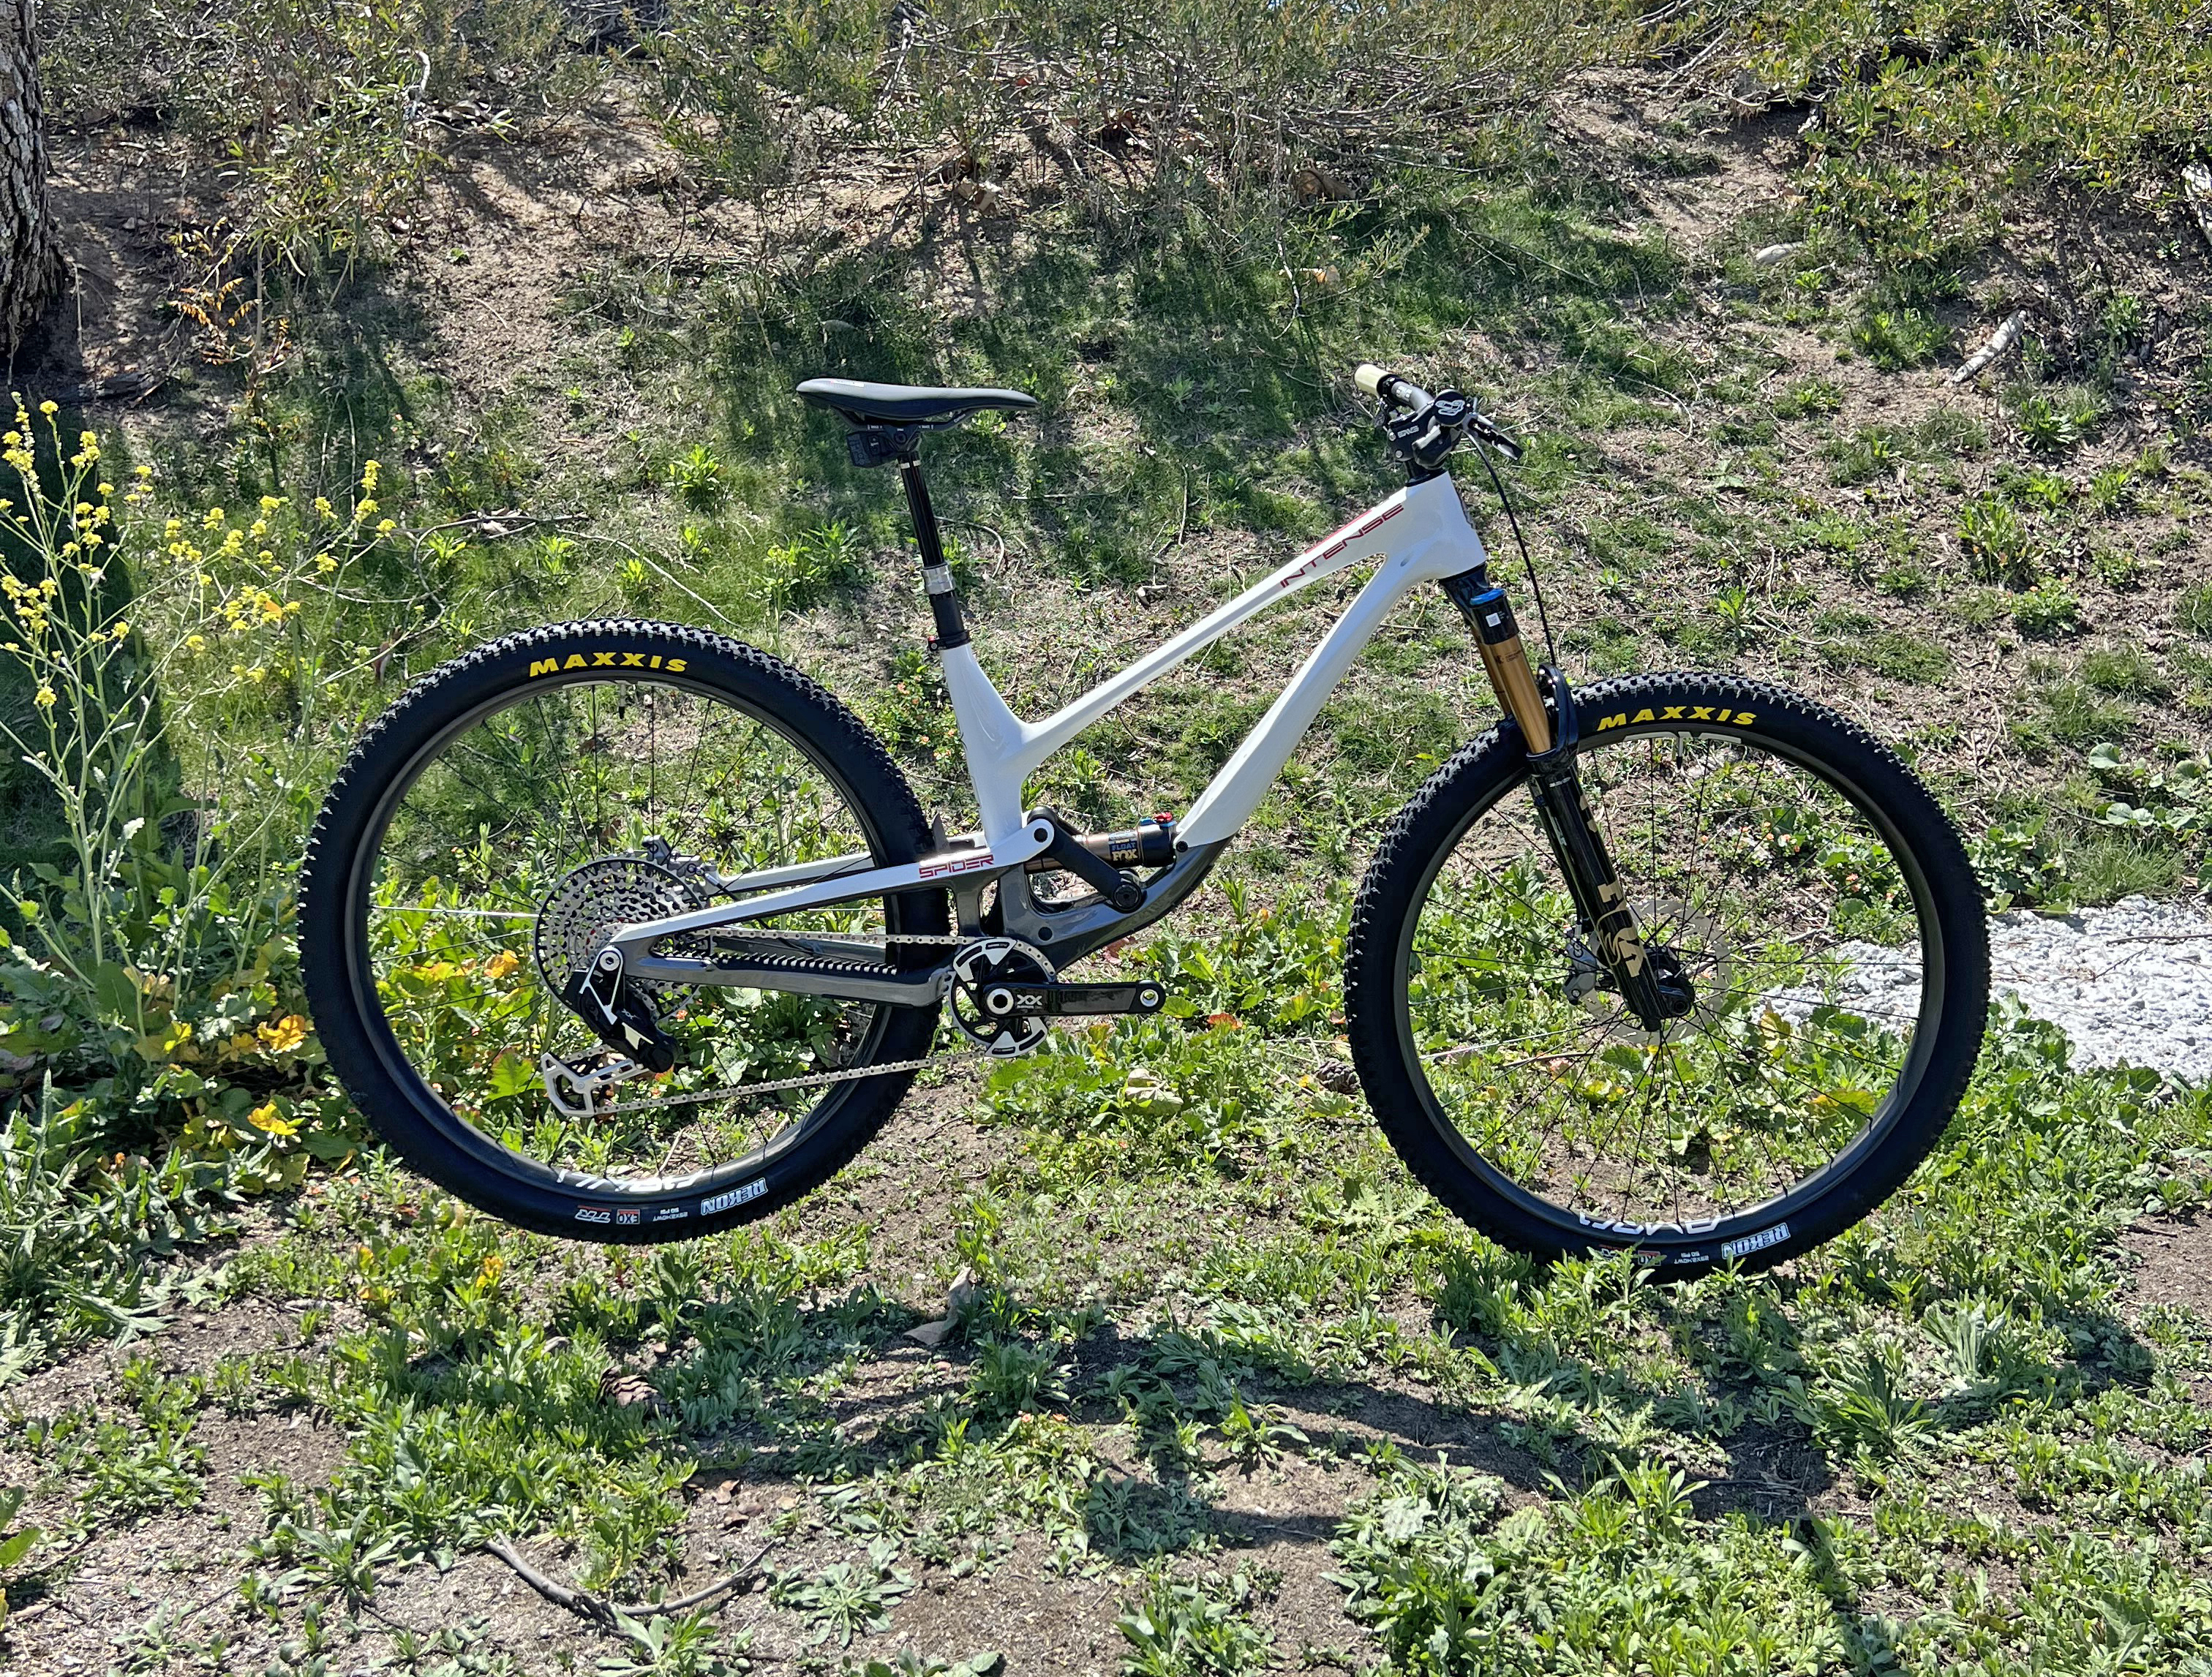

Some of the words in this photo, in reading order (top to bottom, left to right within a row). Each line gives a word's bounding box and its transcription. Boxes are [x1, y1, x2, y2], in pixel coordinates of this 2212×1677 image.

[1280, 502, 1404, 588] INTENSE
[530, 652, 688, 677] MAXXIS
[1597, 706, 1756, 731] MAXXIS
[1112, 842, 1135, 851] FLOAT
[1112, 848, 1138, 862] FOX
[919, 854, 994, 878] SPIDER
[1017, 995, 1042, 1006] XX
[701, 1177, 767, 1215] REKON
[617, 1212, 639, 1224] EXO
[1722, 1222, 1791, 1259] REKON
